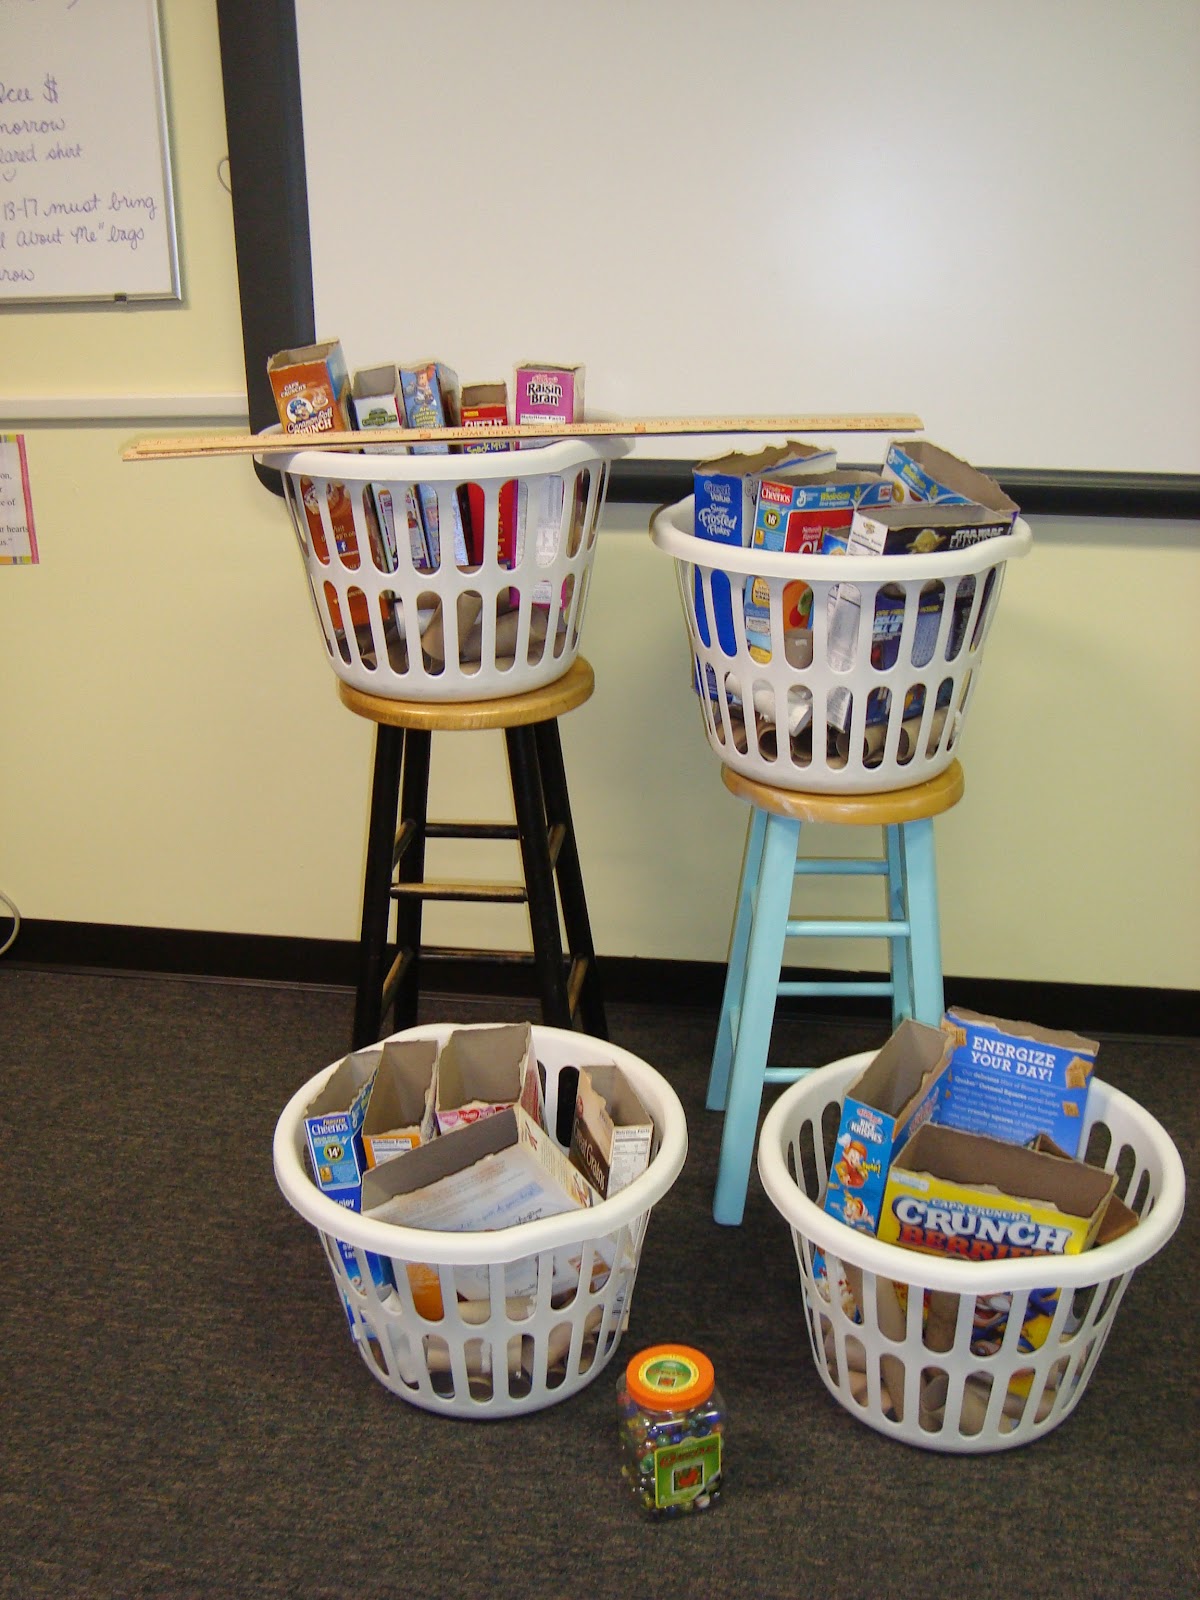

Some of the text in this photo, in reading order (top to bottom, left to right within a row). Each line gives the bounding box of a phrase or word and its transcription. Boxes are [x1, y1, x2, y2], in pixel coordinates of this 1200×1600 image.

[43, 72, 59, 104] $
[44, 194, 101, 217] must
[108, 191, 157, 221] bring
[527, 382, 563, 397] Raisin
[531, 392, 559, 406] Bran
[761, 488, 792, 504] Cheerios
[698, 507, 738, 530] Frosted
[972, 1036, 1056, 1069] ENERGIZE
[971, 1051, 1053, 1082] YOUR DAY!
[311, 1122, 349, 1136] Cheerios
[851, 1121, 882, 1145] KRISPIES
[930, 1199, 1032, 1222] CAP'N CRUNCH'S
[896, 1200, 1072, 1253] CRUNCH
